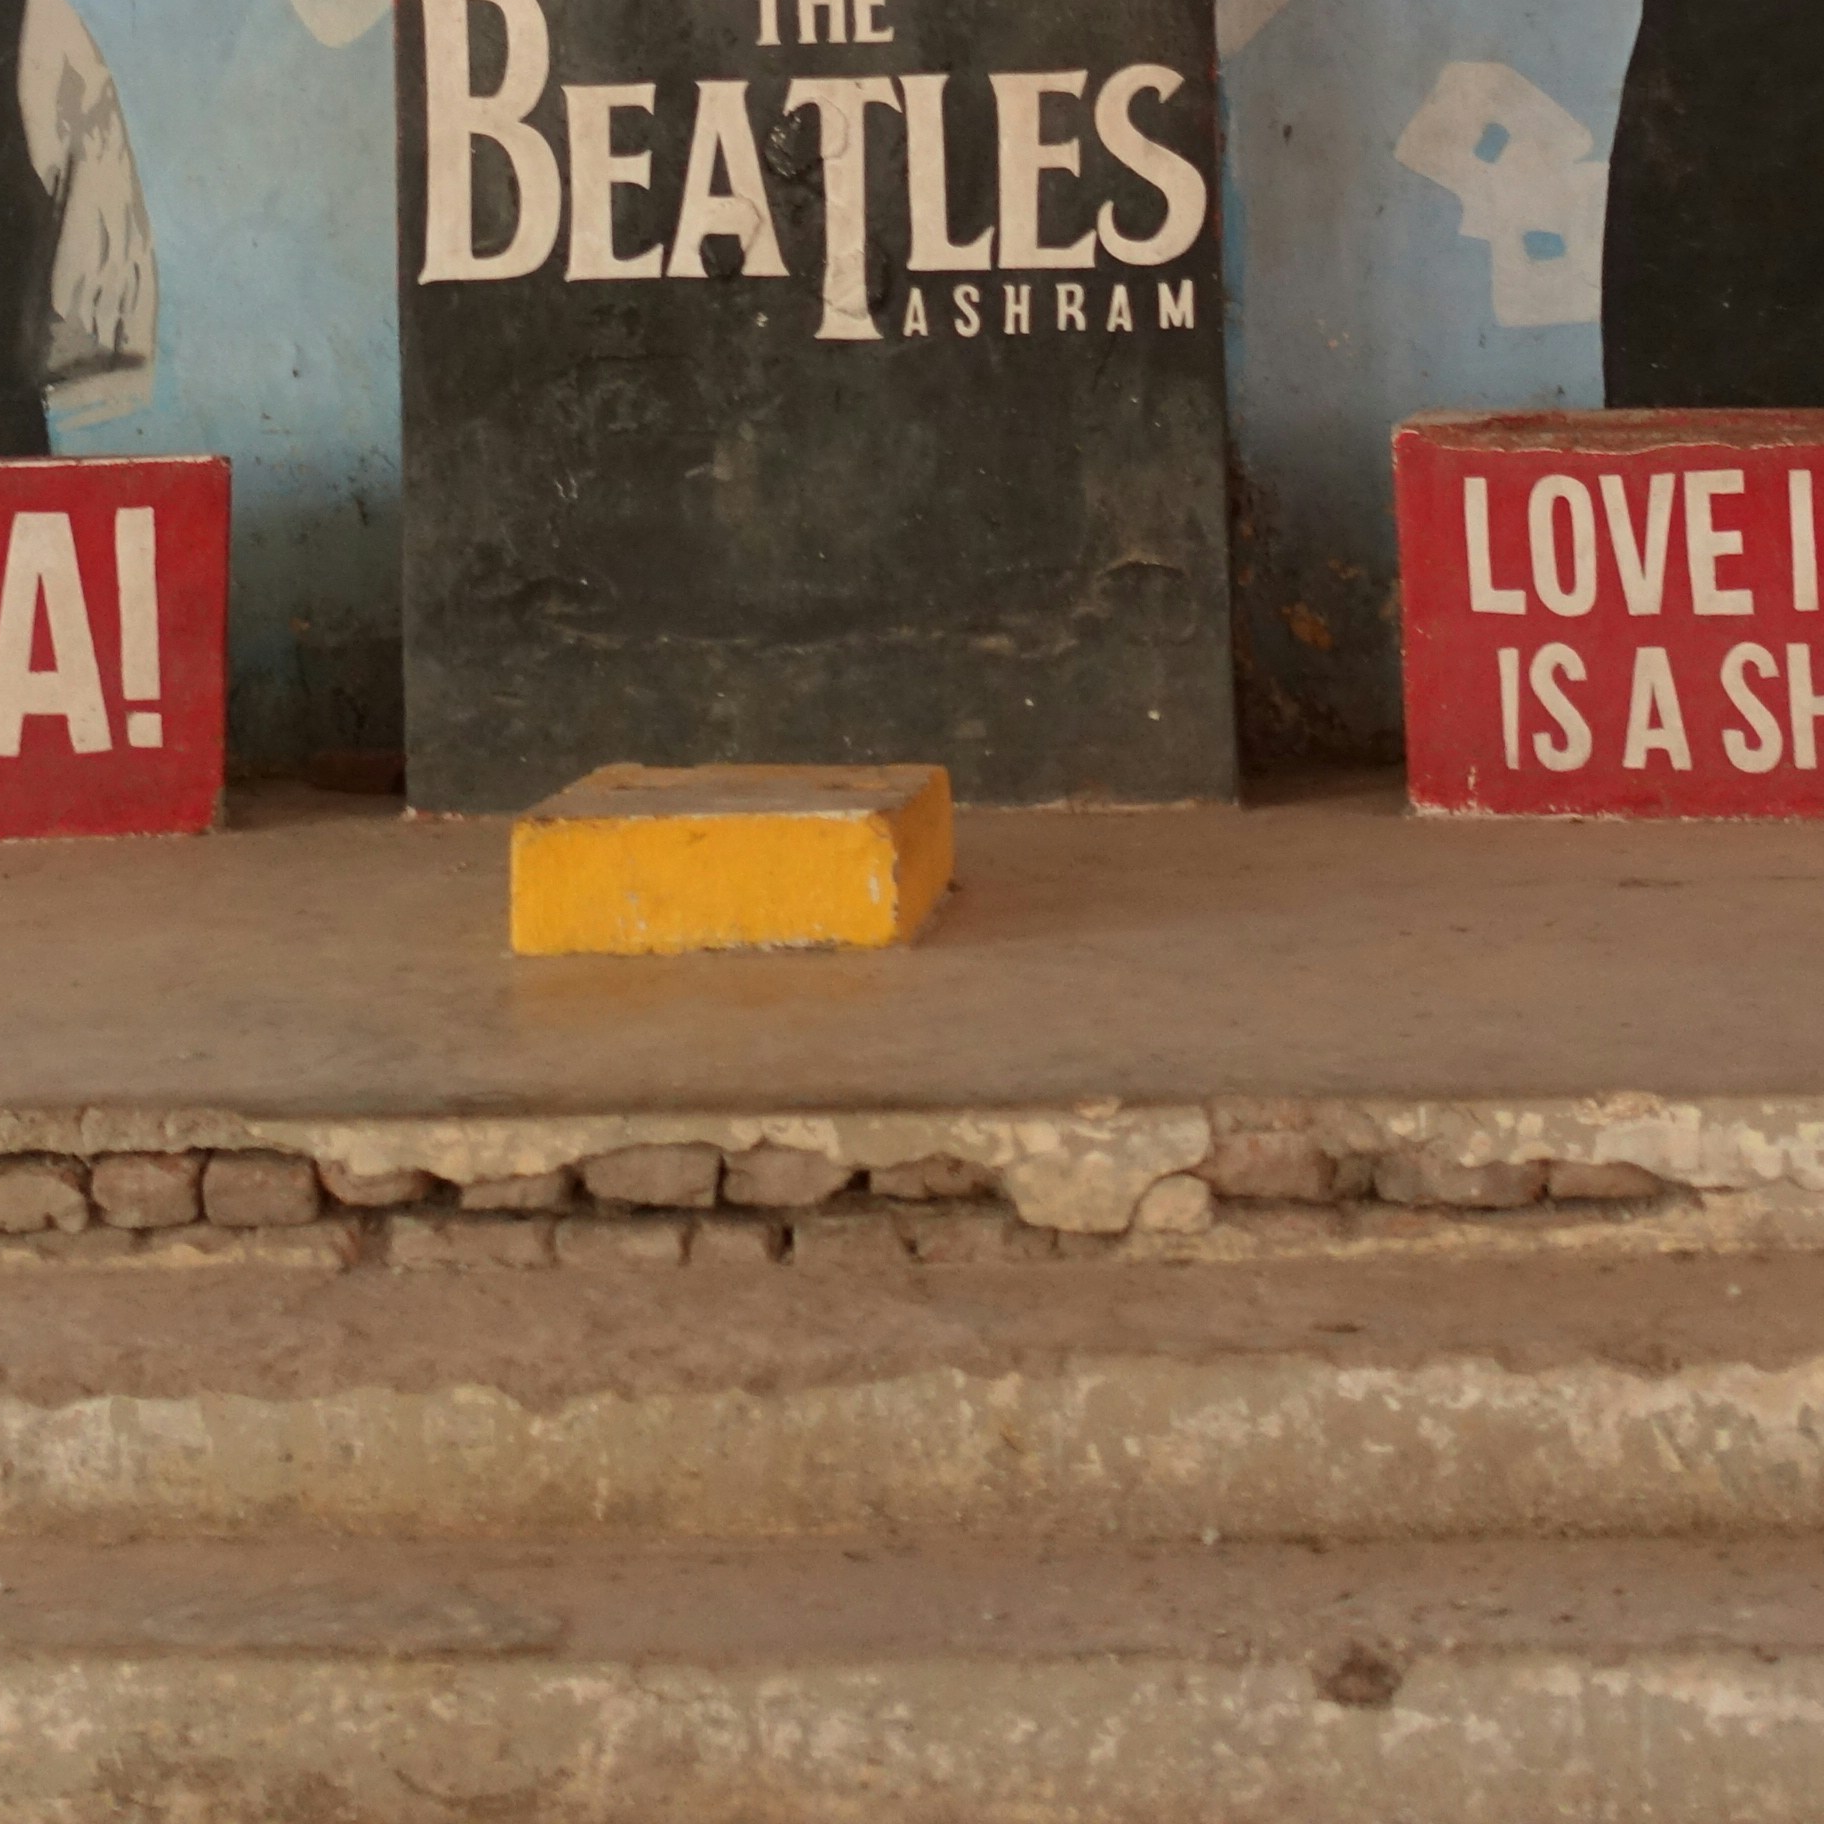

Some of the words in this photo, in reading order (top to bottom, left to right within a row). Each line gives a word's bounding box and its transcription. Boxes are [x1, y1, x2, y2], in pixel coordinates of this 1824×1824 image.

[903, 279, 1195, 338] ASHRAM
[1464, 469, 1754, 617] LOVE
[1497, 642, 1593, 772] IS
[1622, 646, 1692, 771] A
